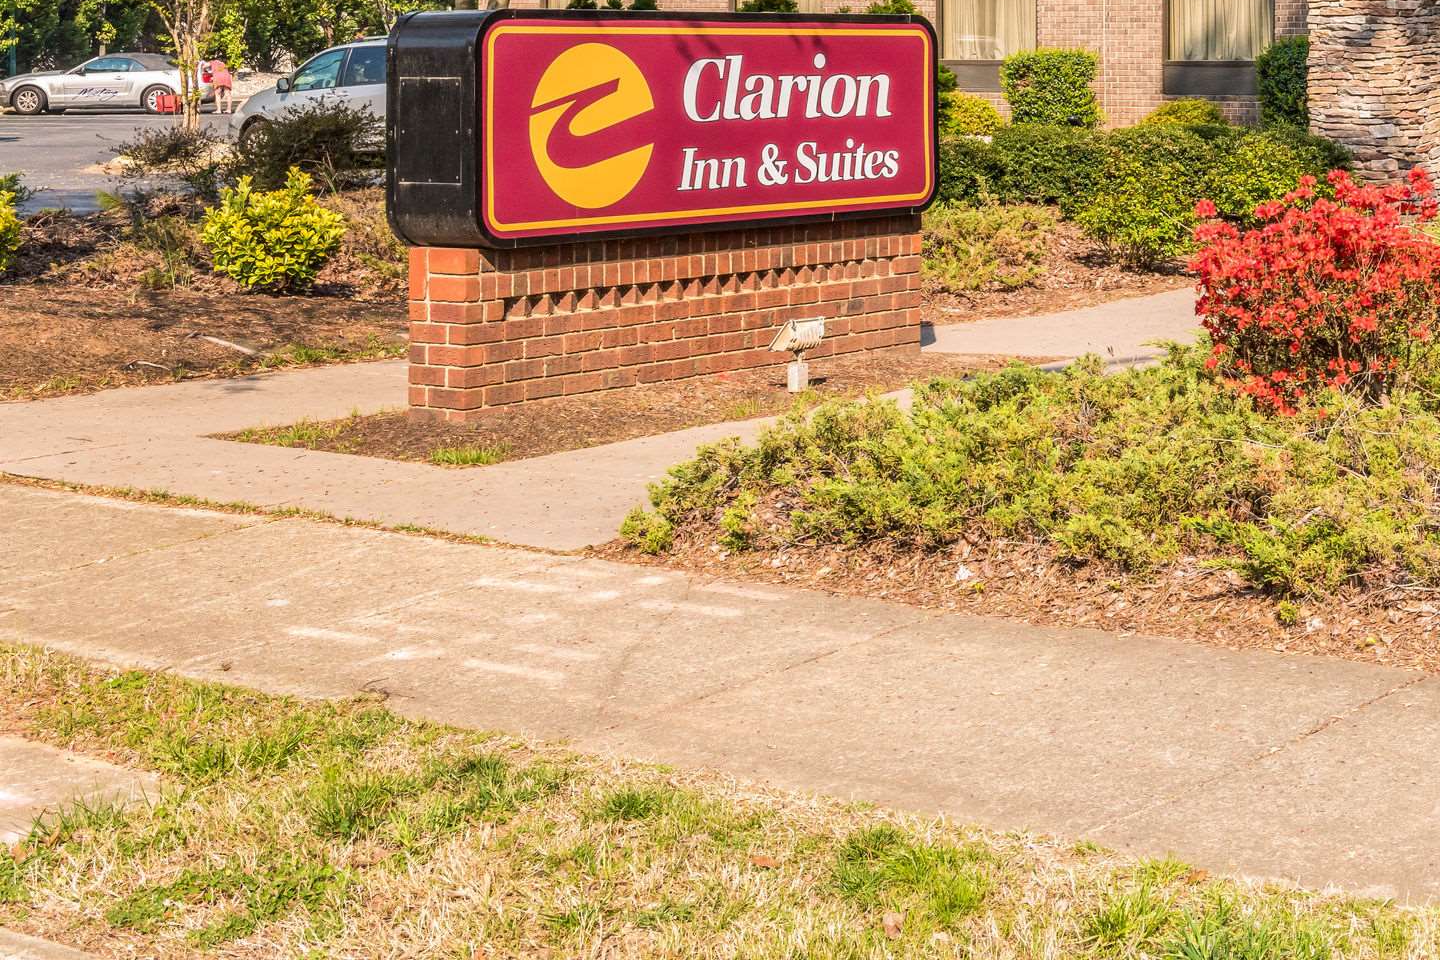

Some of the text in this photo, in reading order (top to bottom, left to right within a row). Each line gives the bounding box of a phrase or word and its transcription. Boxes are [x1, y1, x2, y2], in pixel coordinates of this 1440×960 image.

[682, 53, 892, 122] Clarion
[676, 138, 899, 191] Inn & Suites
